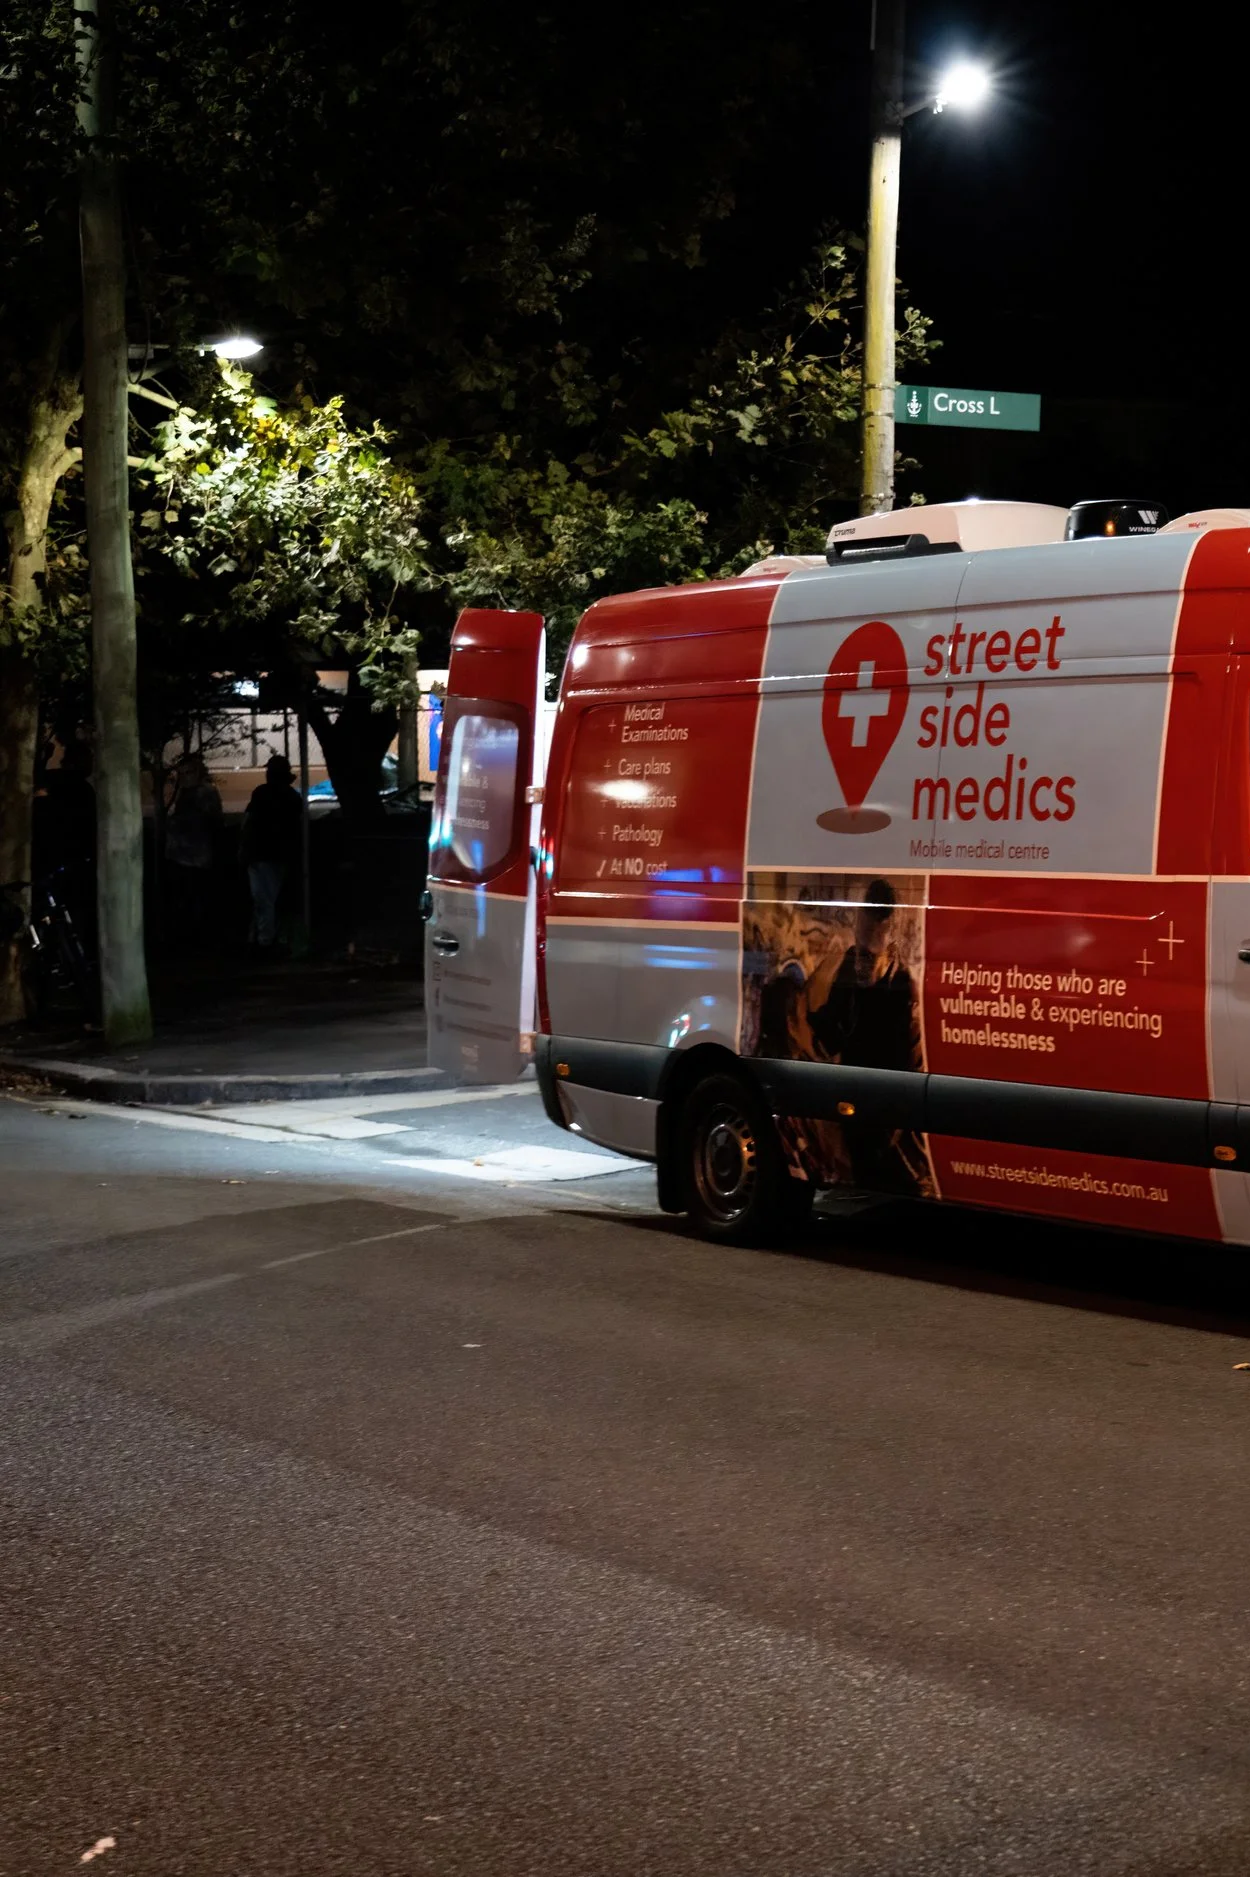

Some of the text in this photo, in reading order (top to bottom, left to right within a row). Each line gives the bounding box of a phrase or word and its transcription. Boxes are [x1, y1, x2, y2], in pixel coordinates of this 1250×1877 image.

[933, 393, 1000, 415] Cross L
[923, 615, 1066, 677] street
[624, 703, 665, 722] Medical
[916, 682, 1011, 749] side
[621, 725, 689, 743] Examinations
[618, 758, 671, 780] Care plans
[912, 754, 1076, 823] medics
[612, 824, 664, 847] Pathology
[909, 839, 1050, 861] Mobile medical centre
[610, 860, 668, 877] At NO cost
[941, 962, 1127, 997] Helping those who are
[940, 991, 1162, 1038] vulnerable & experiencing
[941, 1020, 1056, 1052] homelessness
[950, 1160, 1169, 1202] www.streetsidemedics.com.au
